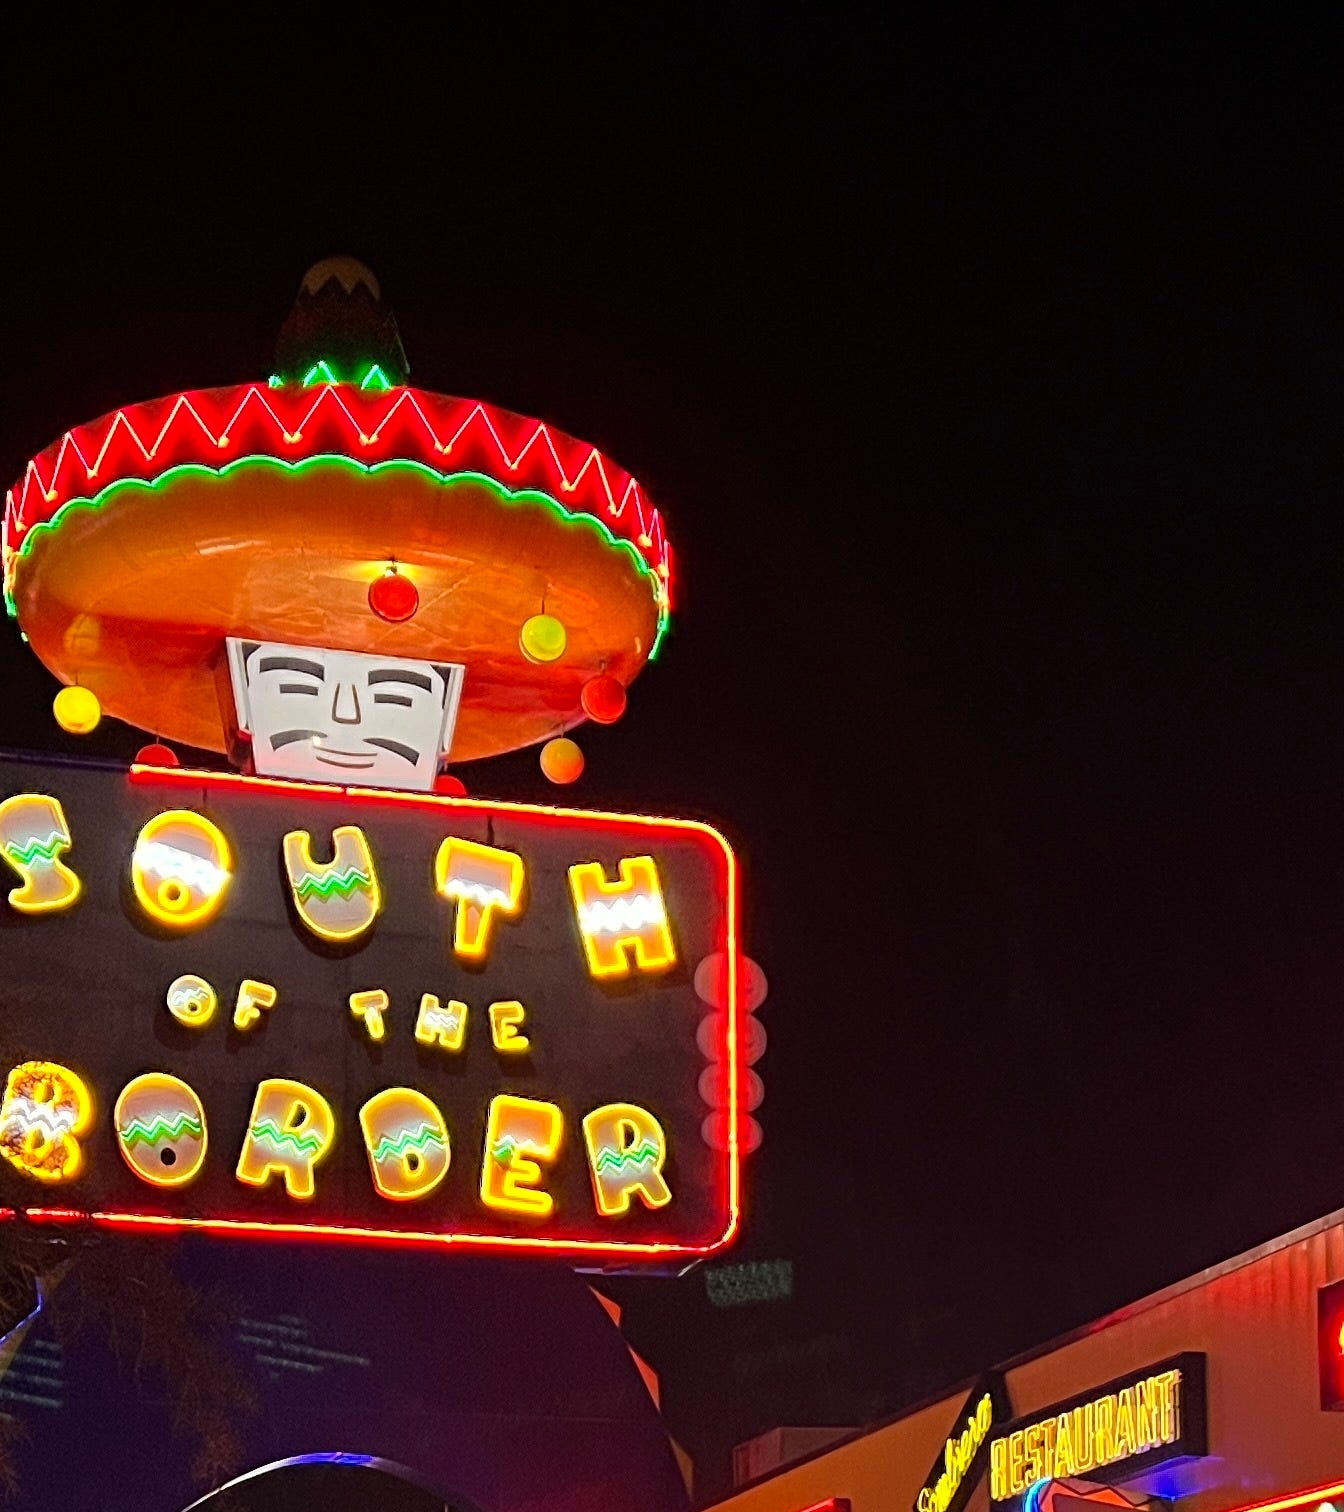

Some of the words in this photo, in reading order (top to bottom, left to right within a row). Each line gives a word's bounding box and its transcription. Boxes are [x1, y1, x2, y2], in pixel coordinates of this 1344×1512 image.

[166, 974, 277, 1030] OF
[349, 988, 530, 1052] THE
[990, 1368, 1183, 1502] RESTAURANT
